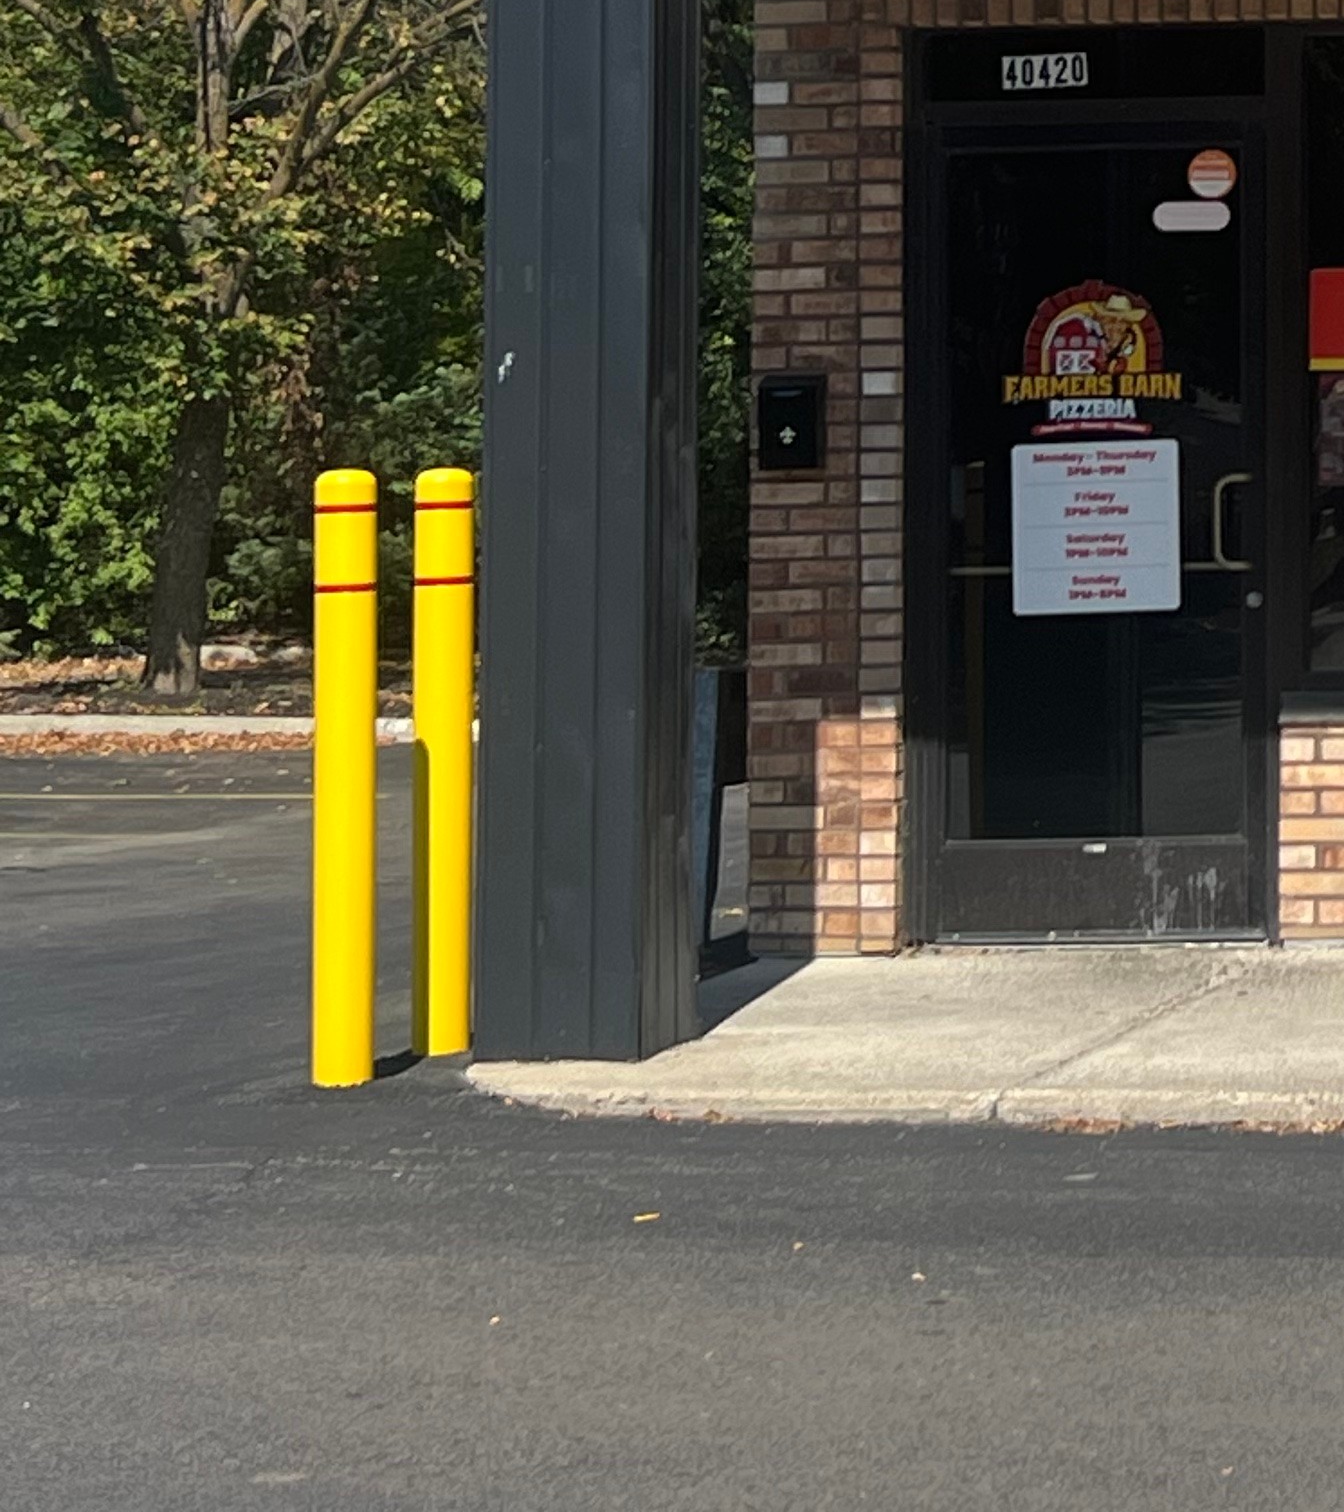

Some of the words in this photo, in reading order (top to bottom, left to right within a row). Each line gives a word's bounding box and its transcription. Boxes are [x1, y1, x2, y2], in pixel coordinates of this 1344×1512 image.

[1005, 54, 1085, 87] 40420
[1003, 375, 1113, 403] FARMERS
[1120, 373, 1182, 400] BARN
[1049, 398, 1137, 420] PIZZERIA
[1032, 452, 1085, 465] Monday
[1096, 449, 1157, 462] Thursday
[1074, 492, 1116, 504] Friday
[1066, 533, 1126, 546] Saturday
[1071, 574, 1121, 587] Sunday
